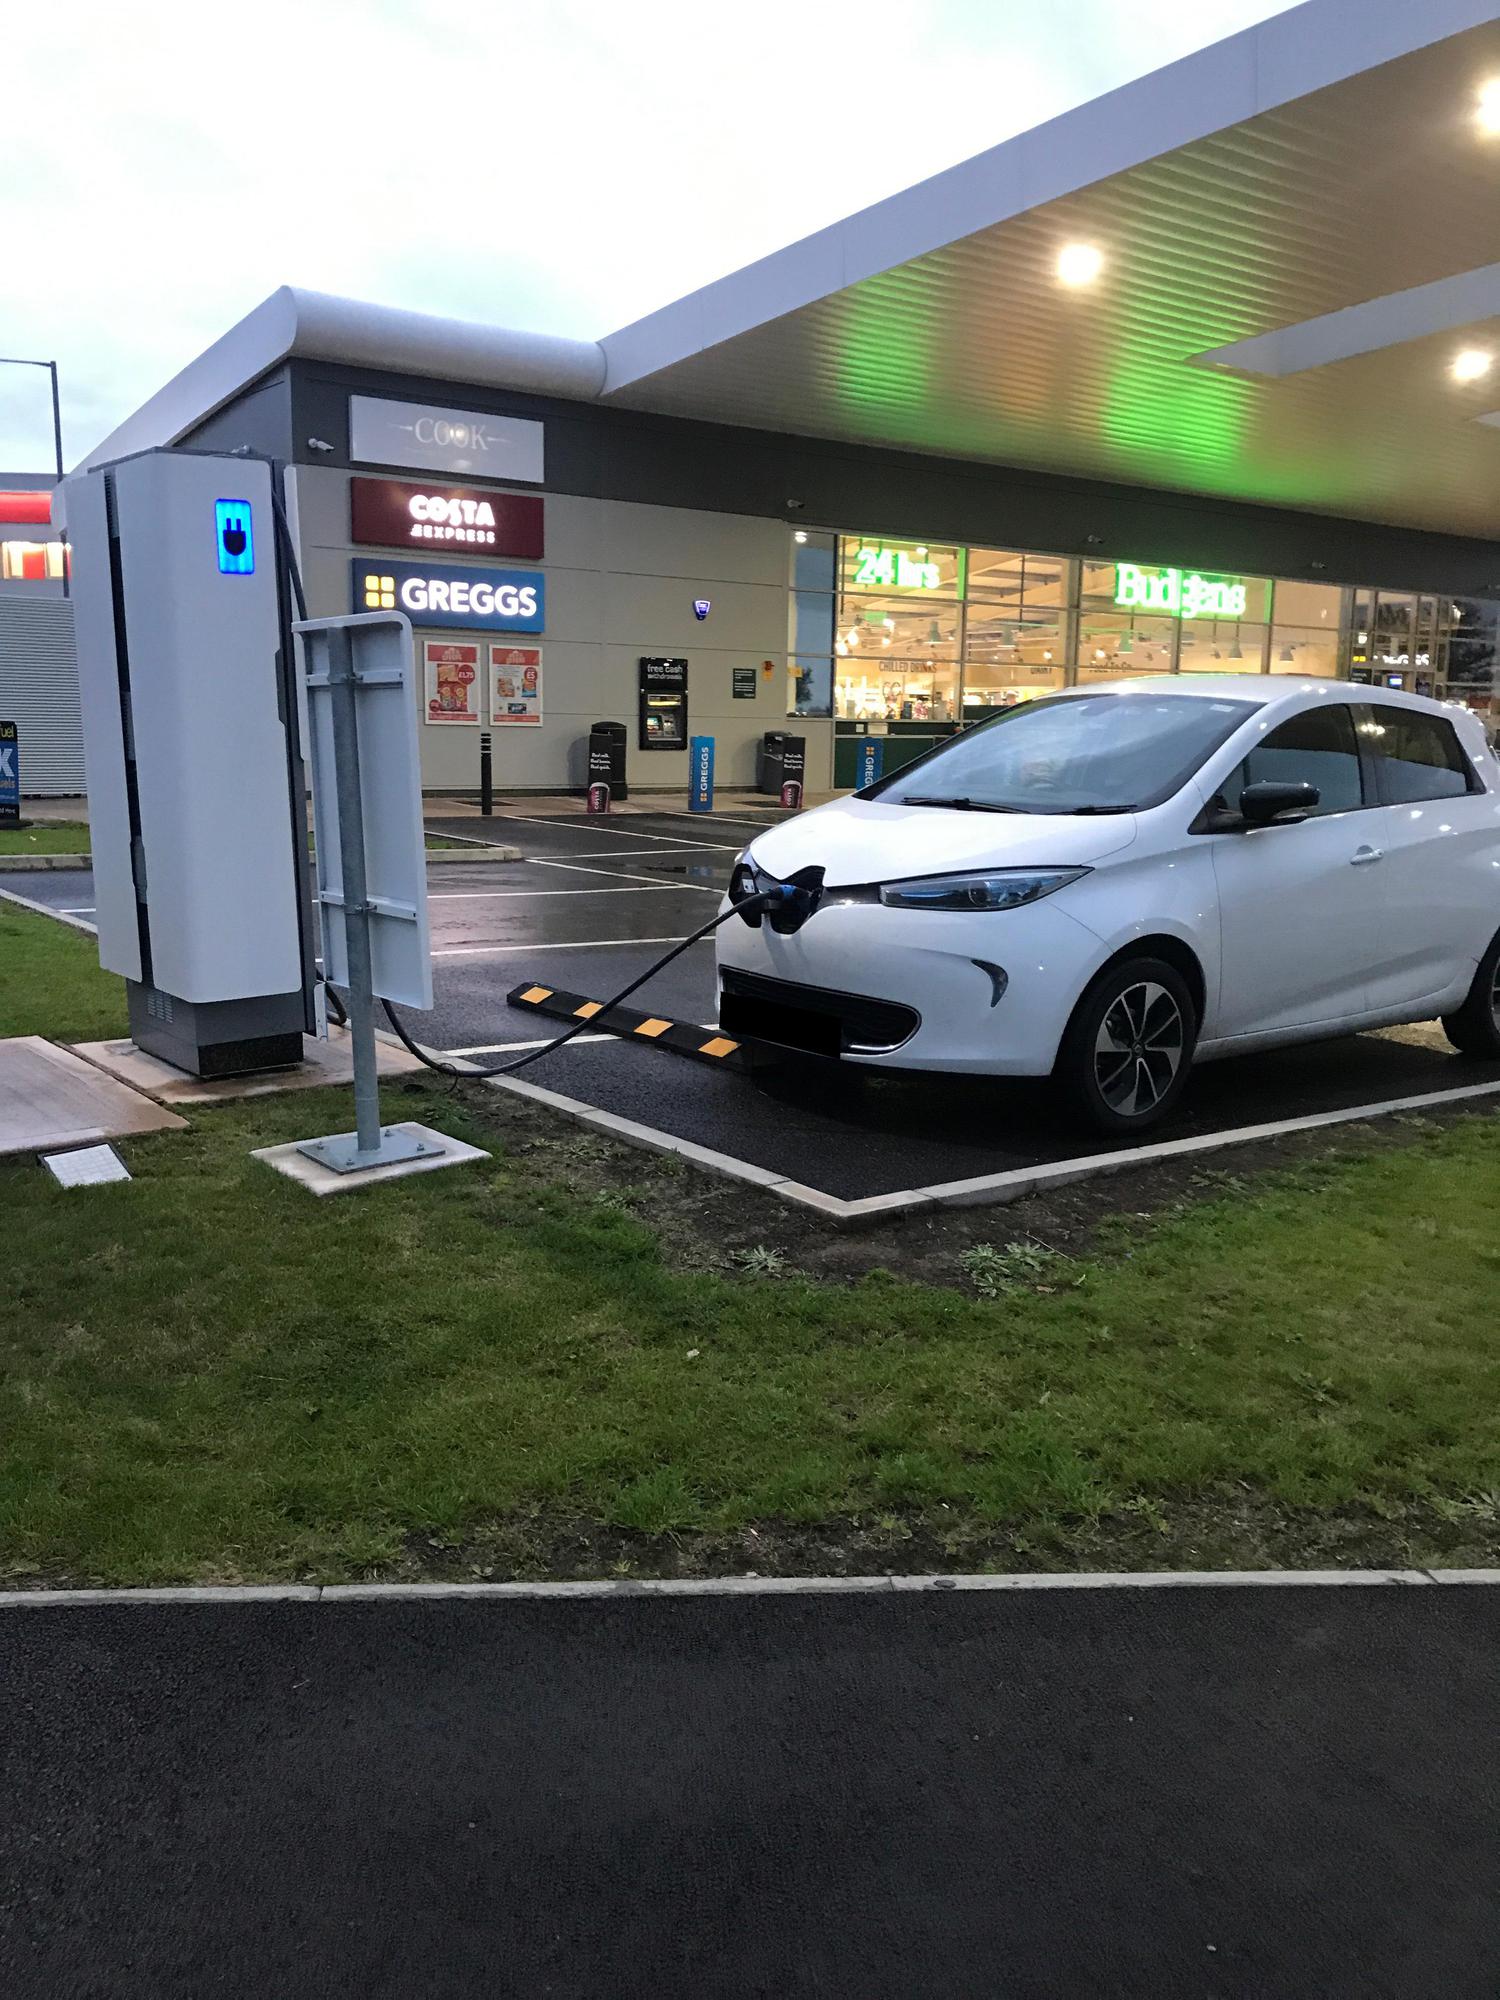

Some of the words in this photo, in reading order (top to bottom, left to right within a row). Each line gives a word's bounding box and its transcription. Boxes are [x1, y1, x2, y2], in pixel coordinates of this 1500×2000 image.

[415, 417, 489, 450] COOK
[409, 494, 496, 527] COSTA
[422, 524, 496, 544] EXPRESS
[855, 547, 893, 585] 24
[897, 550, 940, 589] hrs
[401, 577, 538, 617] GREGGS
[1114, 562, 1247, 619] Budgens
[647, 663, 664, 673] free
[664, 664, 683, 673] cash
[0, 725, 14, 738] uel
[700, 746, 709, 791] GREGGS
[864, 757, 875, 785] GREG
